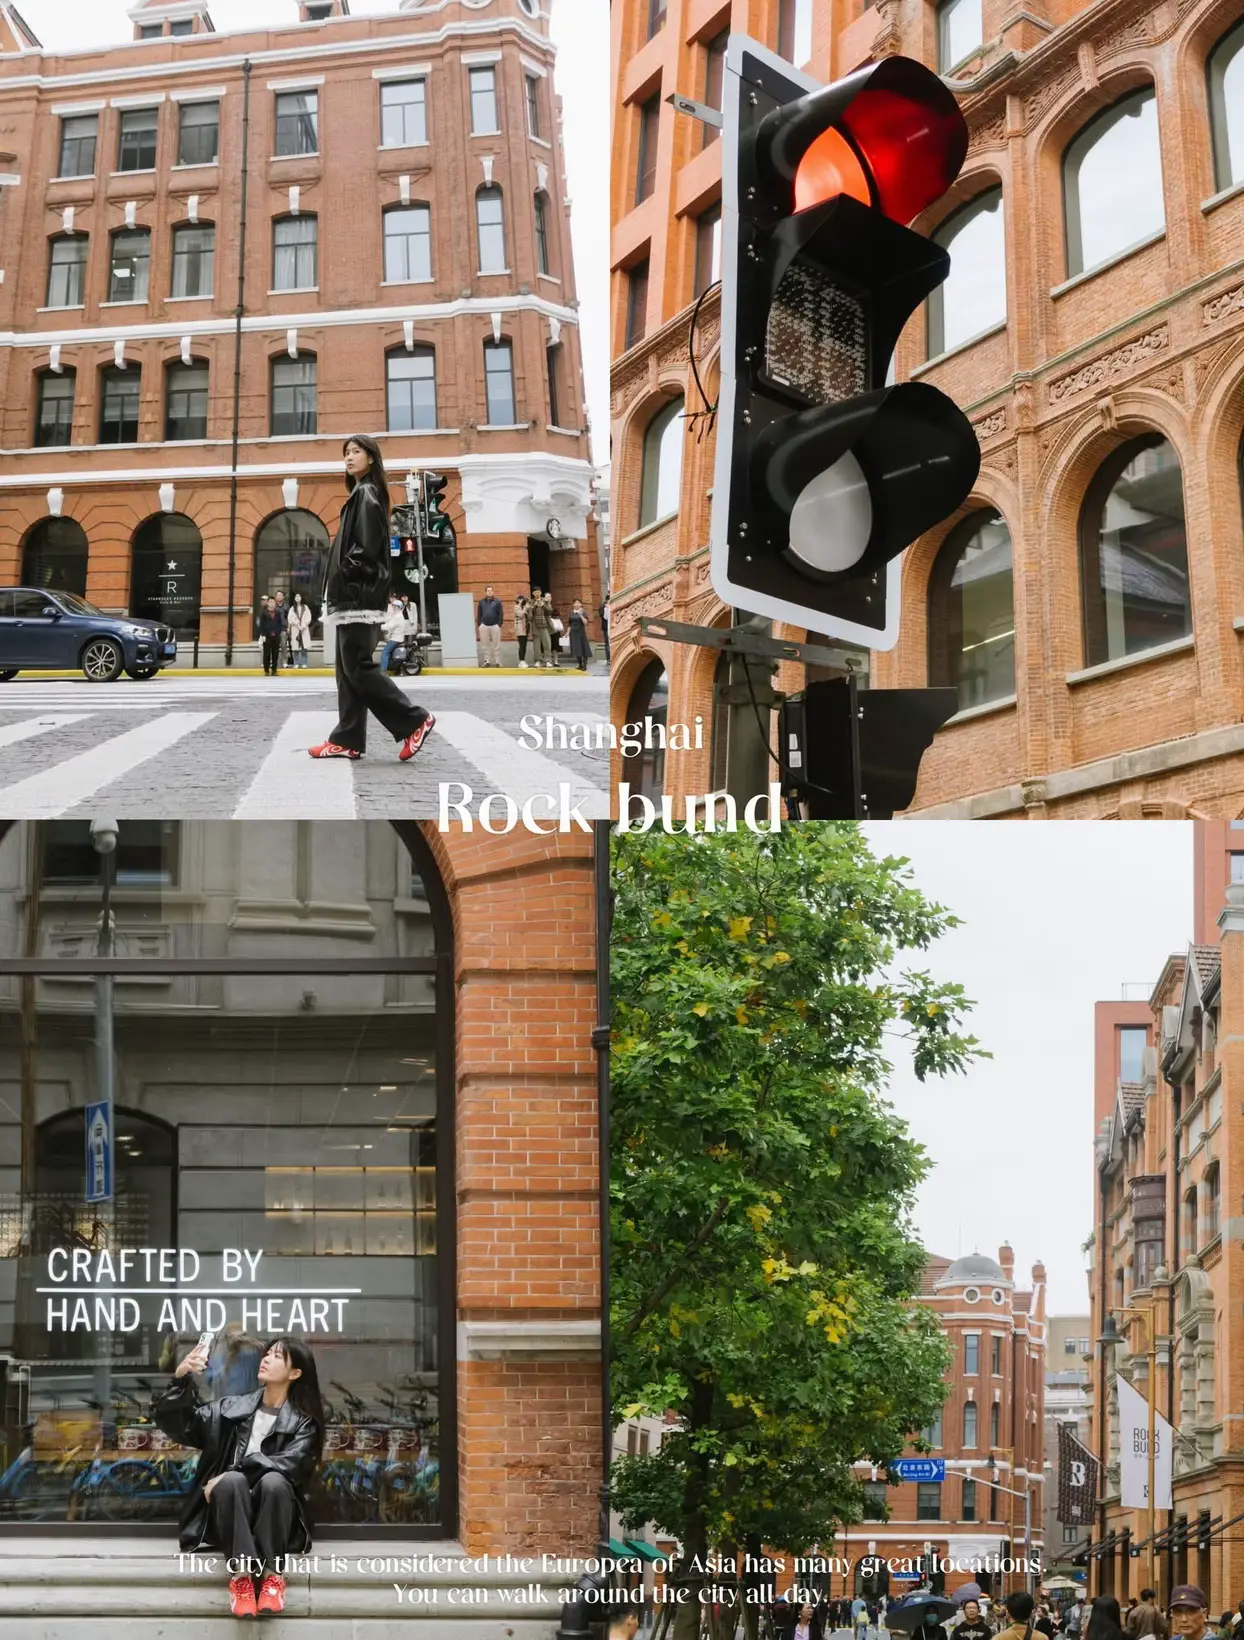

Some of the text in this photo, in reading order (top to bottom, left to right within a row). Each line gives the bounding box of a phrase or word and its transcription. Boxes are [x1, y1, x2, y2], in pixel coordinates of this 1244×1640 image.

[167, 581, 177, 593] R
[48, 1248, 264, 1282] CRAFTED BY
[47, 1298, 350, 1332] HAND AND HEART
[1133, 1428, 1160, 1441] ROK
[1133, 1441, 1160, 1454] BUD
